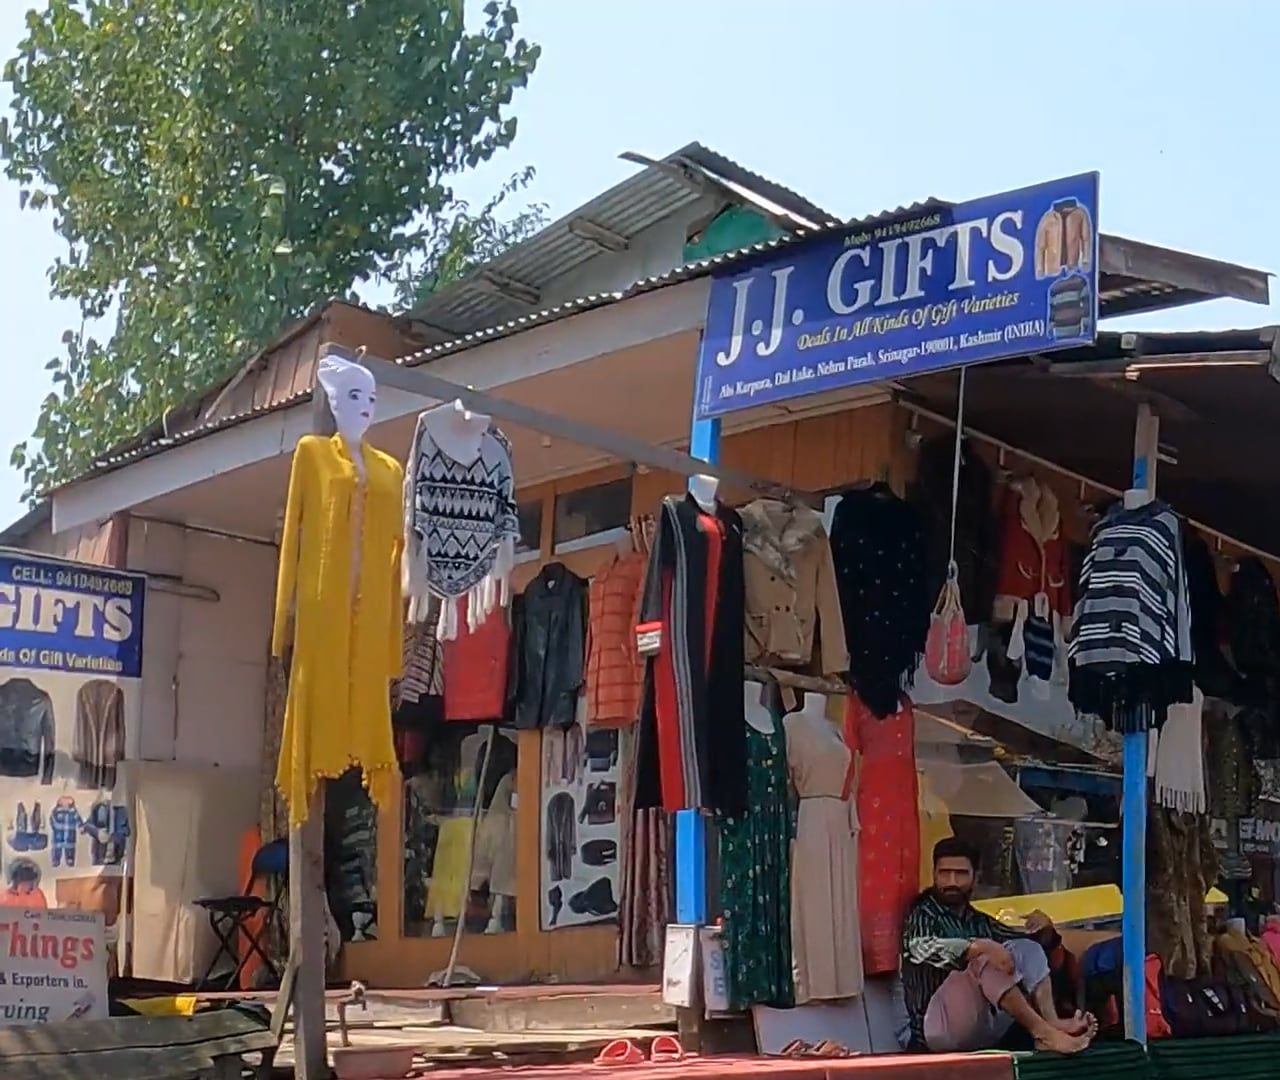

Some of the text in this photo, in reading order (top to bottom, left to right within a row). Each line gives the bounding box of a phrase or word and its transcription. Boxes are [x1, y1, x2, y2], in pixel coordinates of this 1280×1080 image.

[716, 209, 1024, 367] J.J. GIFTS
[797, 290, 1020, 350] Deals In All Kinds Of Gift Varieties
[817, 361, 846, 377] Nehru
[960, 328, 1003, 348] Kashmir
[1004, 320, 1044, 343] (INDIA)
[19, 648, 36, 664] Of
[40, 650, 62, 666] Gift
[12, 972, 69, 988] Exporters
